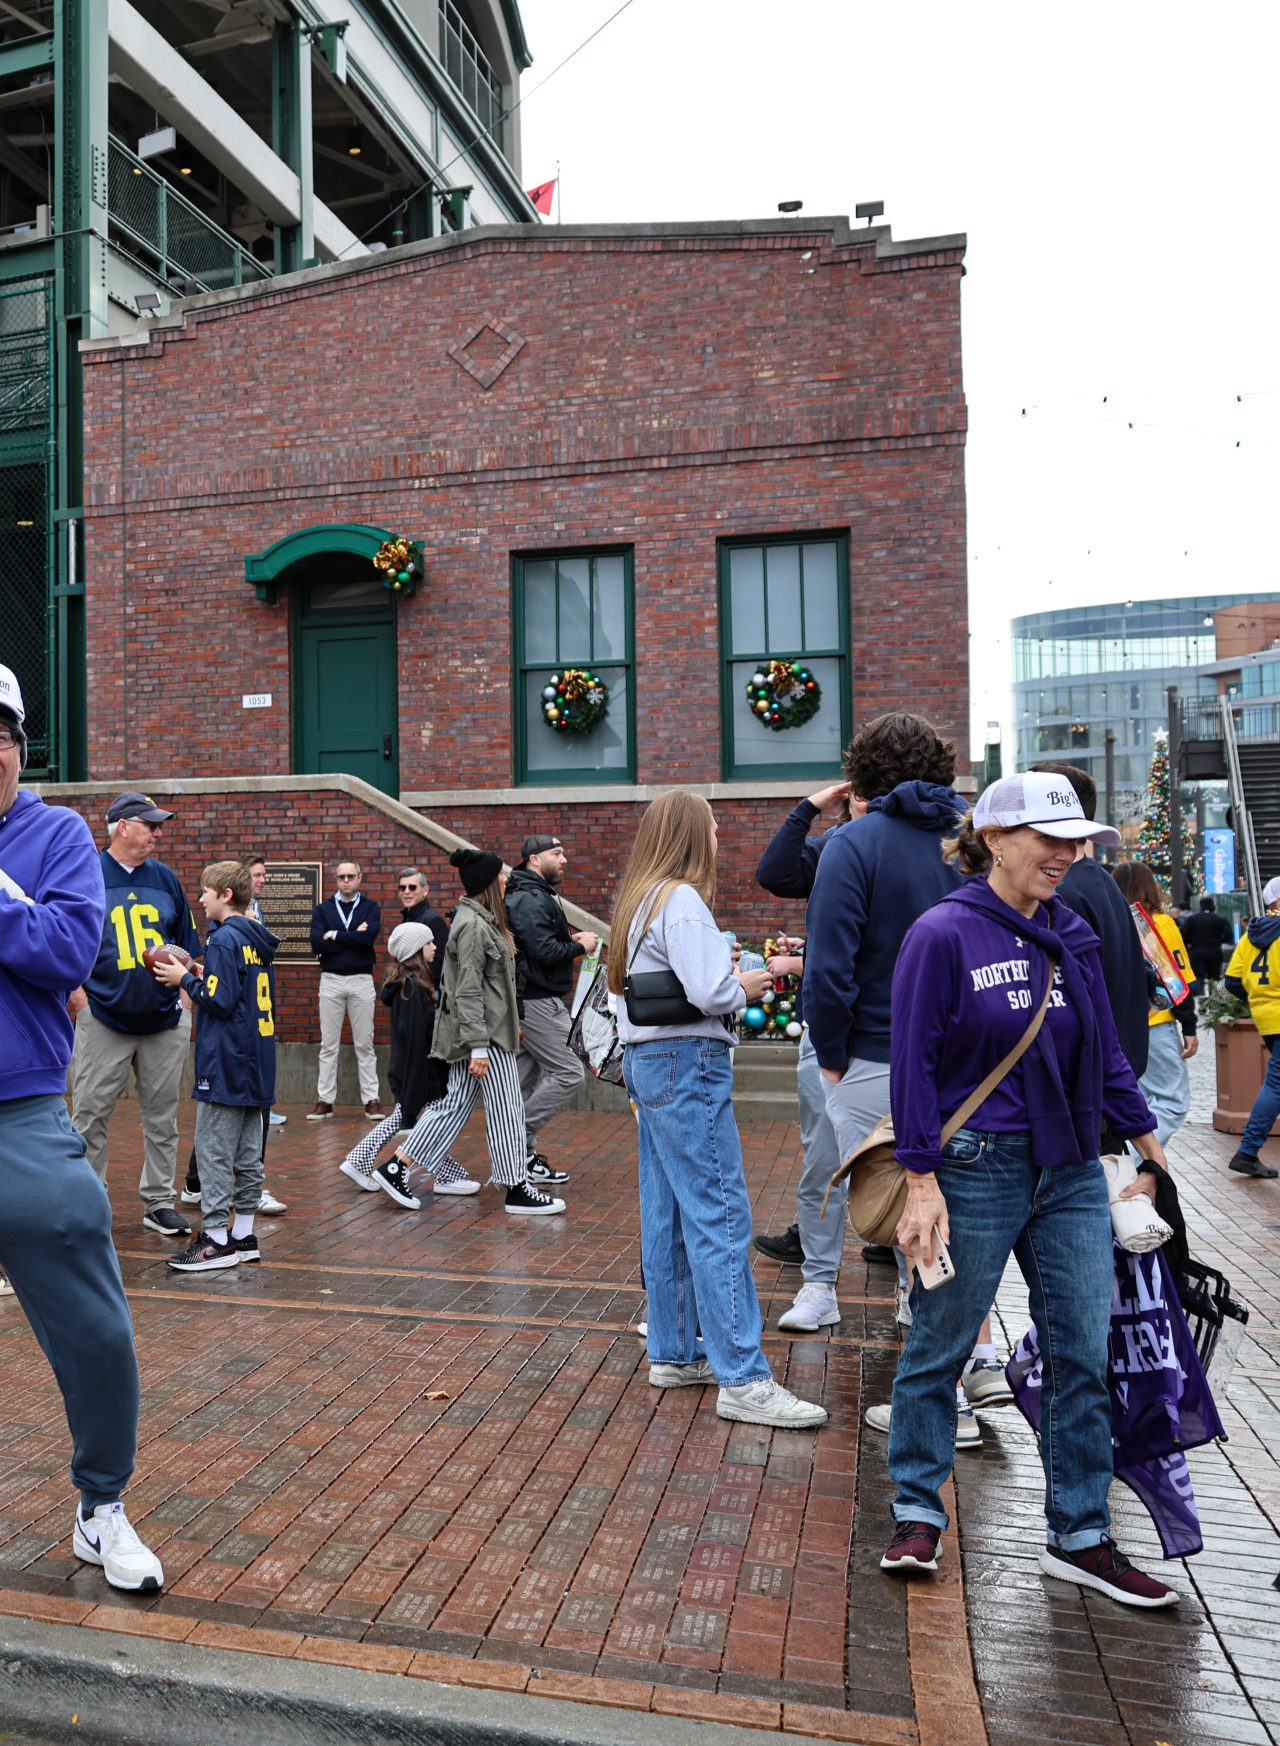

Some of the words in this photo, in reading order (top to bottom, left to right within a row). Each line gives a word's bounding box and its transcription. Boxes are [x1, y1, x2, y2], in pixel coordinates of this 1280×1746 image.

[248, 696, 266, 705] 1053
[1046, 791, 1071, 808] Big
[110, 903, 164, 971] 16
[1250, 949, 1270, 985] 4
[206, 974, 219, 998] 9
[256, 972, 275, 1037] 9
